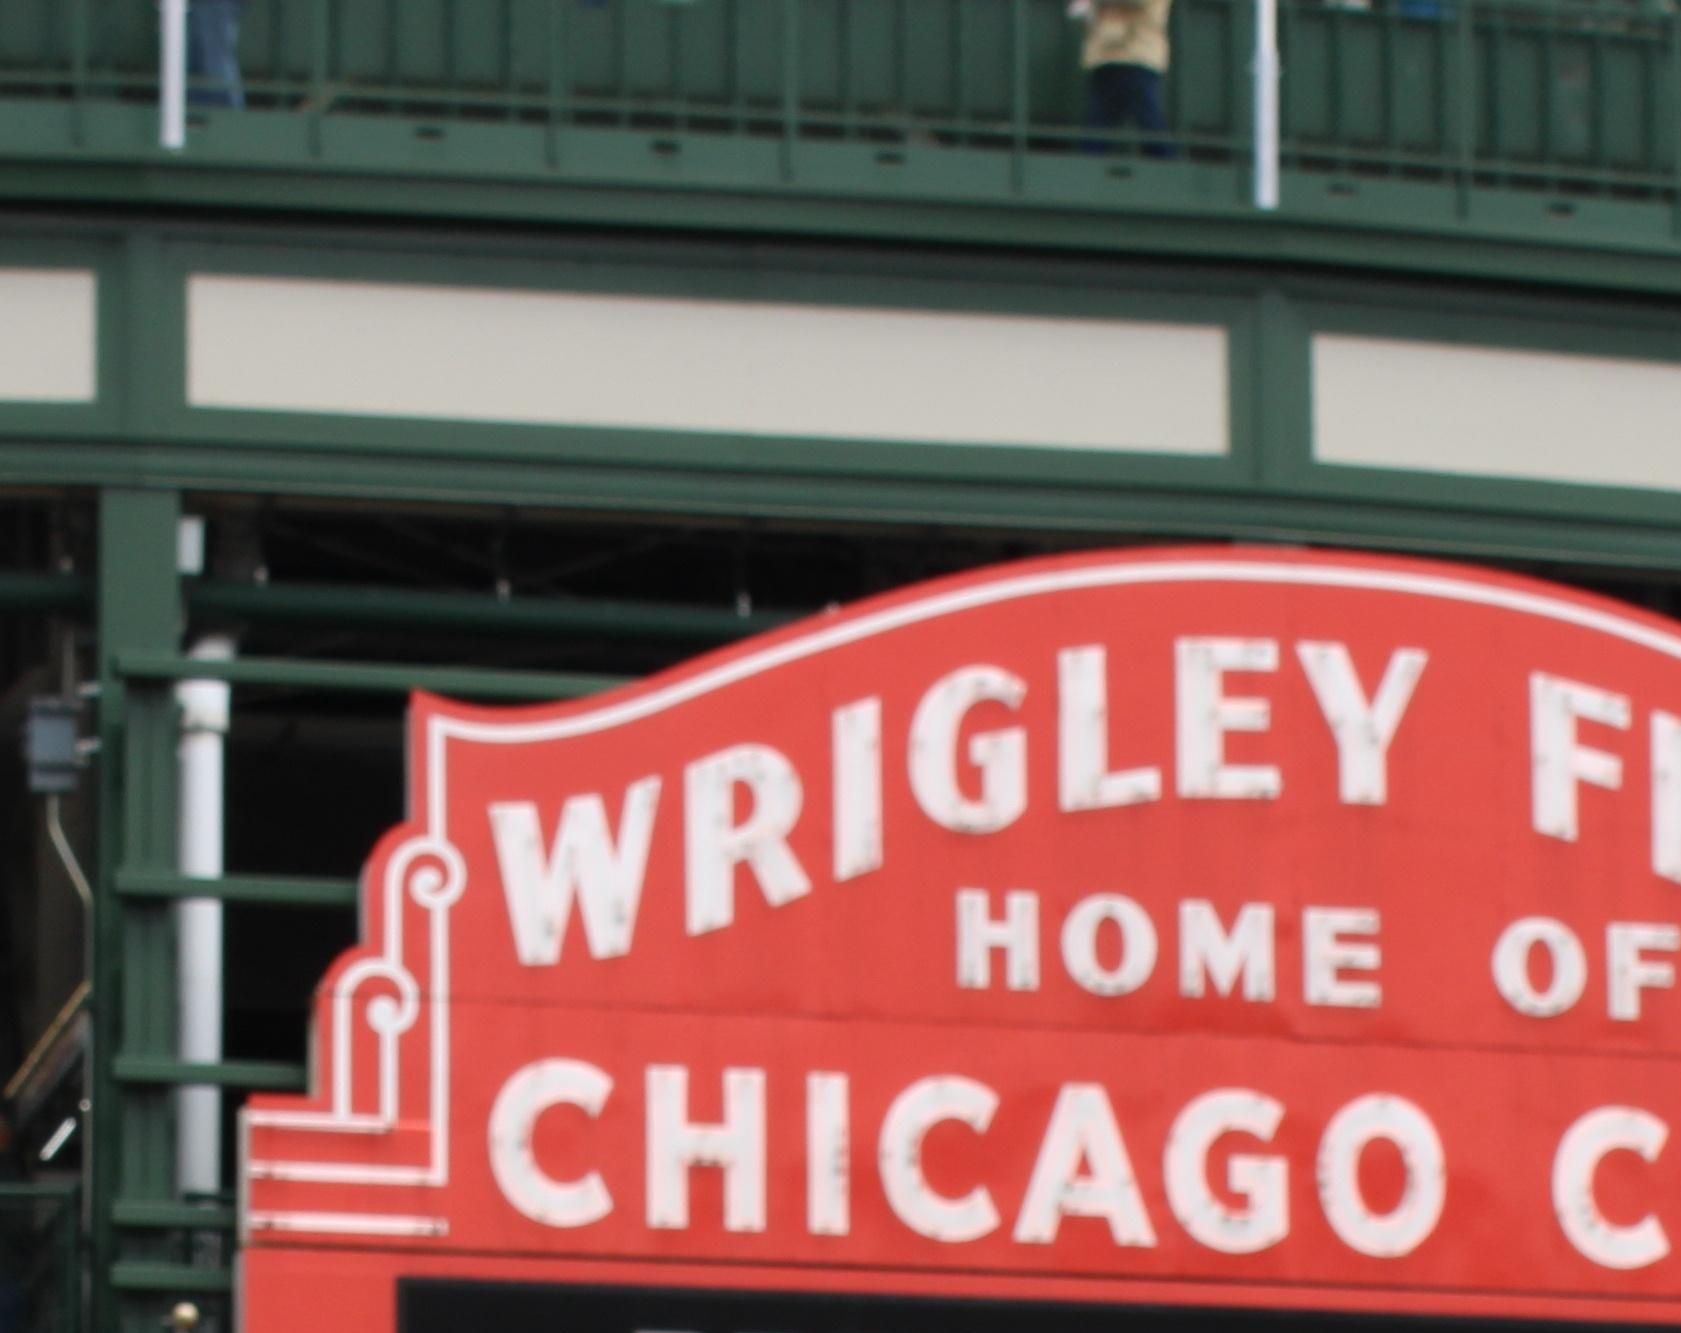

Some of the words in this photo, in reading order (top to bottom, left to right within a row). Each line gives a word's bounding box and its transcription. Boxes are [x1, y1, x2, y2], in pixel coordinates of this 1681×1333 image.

[489, 636, 1428, 966] WRIGLEY
[955, 888, 1382, 1008] HOME
[1490, 916, 1681, 1021] OF
[487, 1057, 1446, 1258] CHICAGO
